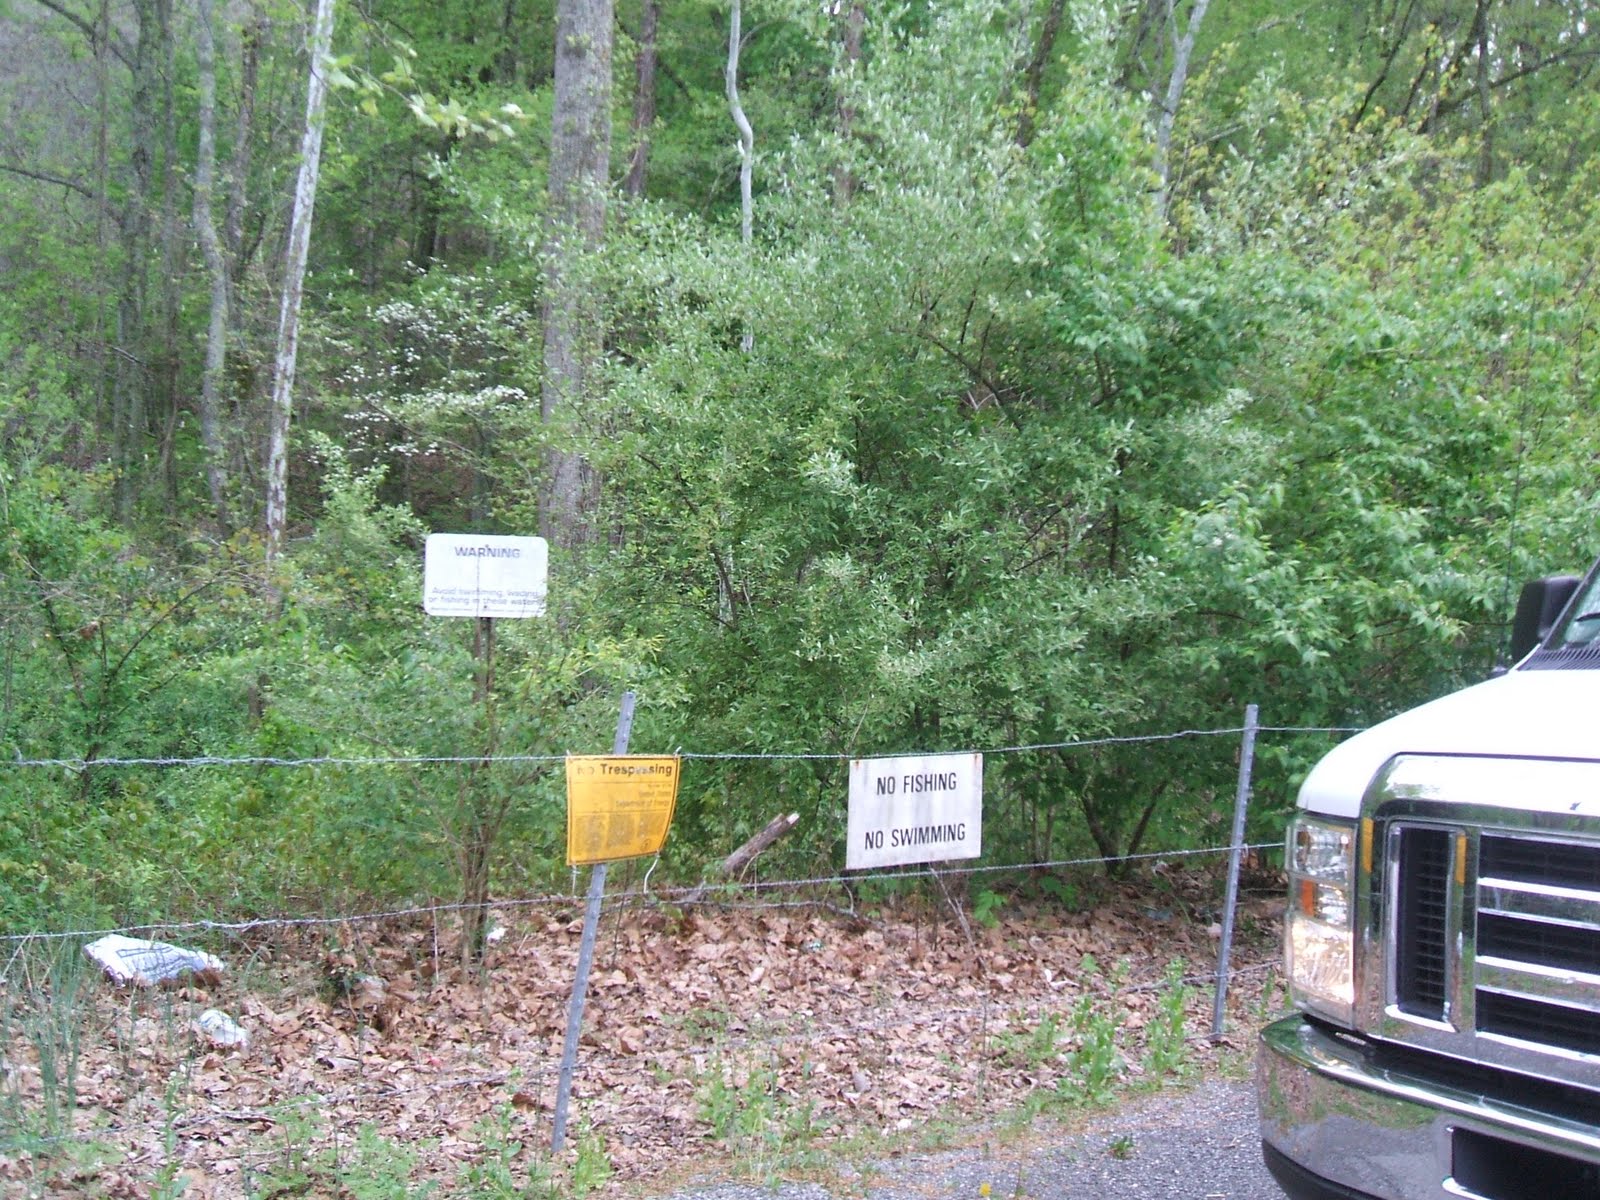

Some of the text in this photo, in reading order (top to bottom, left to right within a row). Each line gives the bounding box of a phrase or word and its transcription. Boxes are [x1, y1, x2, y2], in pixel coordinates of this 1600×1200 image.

[454, 546, 521, 559] WARNING
[432, 587, 454, 595] Avoid
[440, 595, 470, 606] fishing
[482, 596, 507, 605] these
[600, 763, 672, 777] Trespassing
[876, 772, 957, 796] NO FISHING
[865, 823, 966, 850] NO SWIMMING
